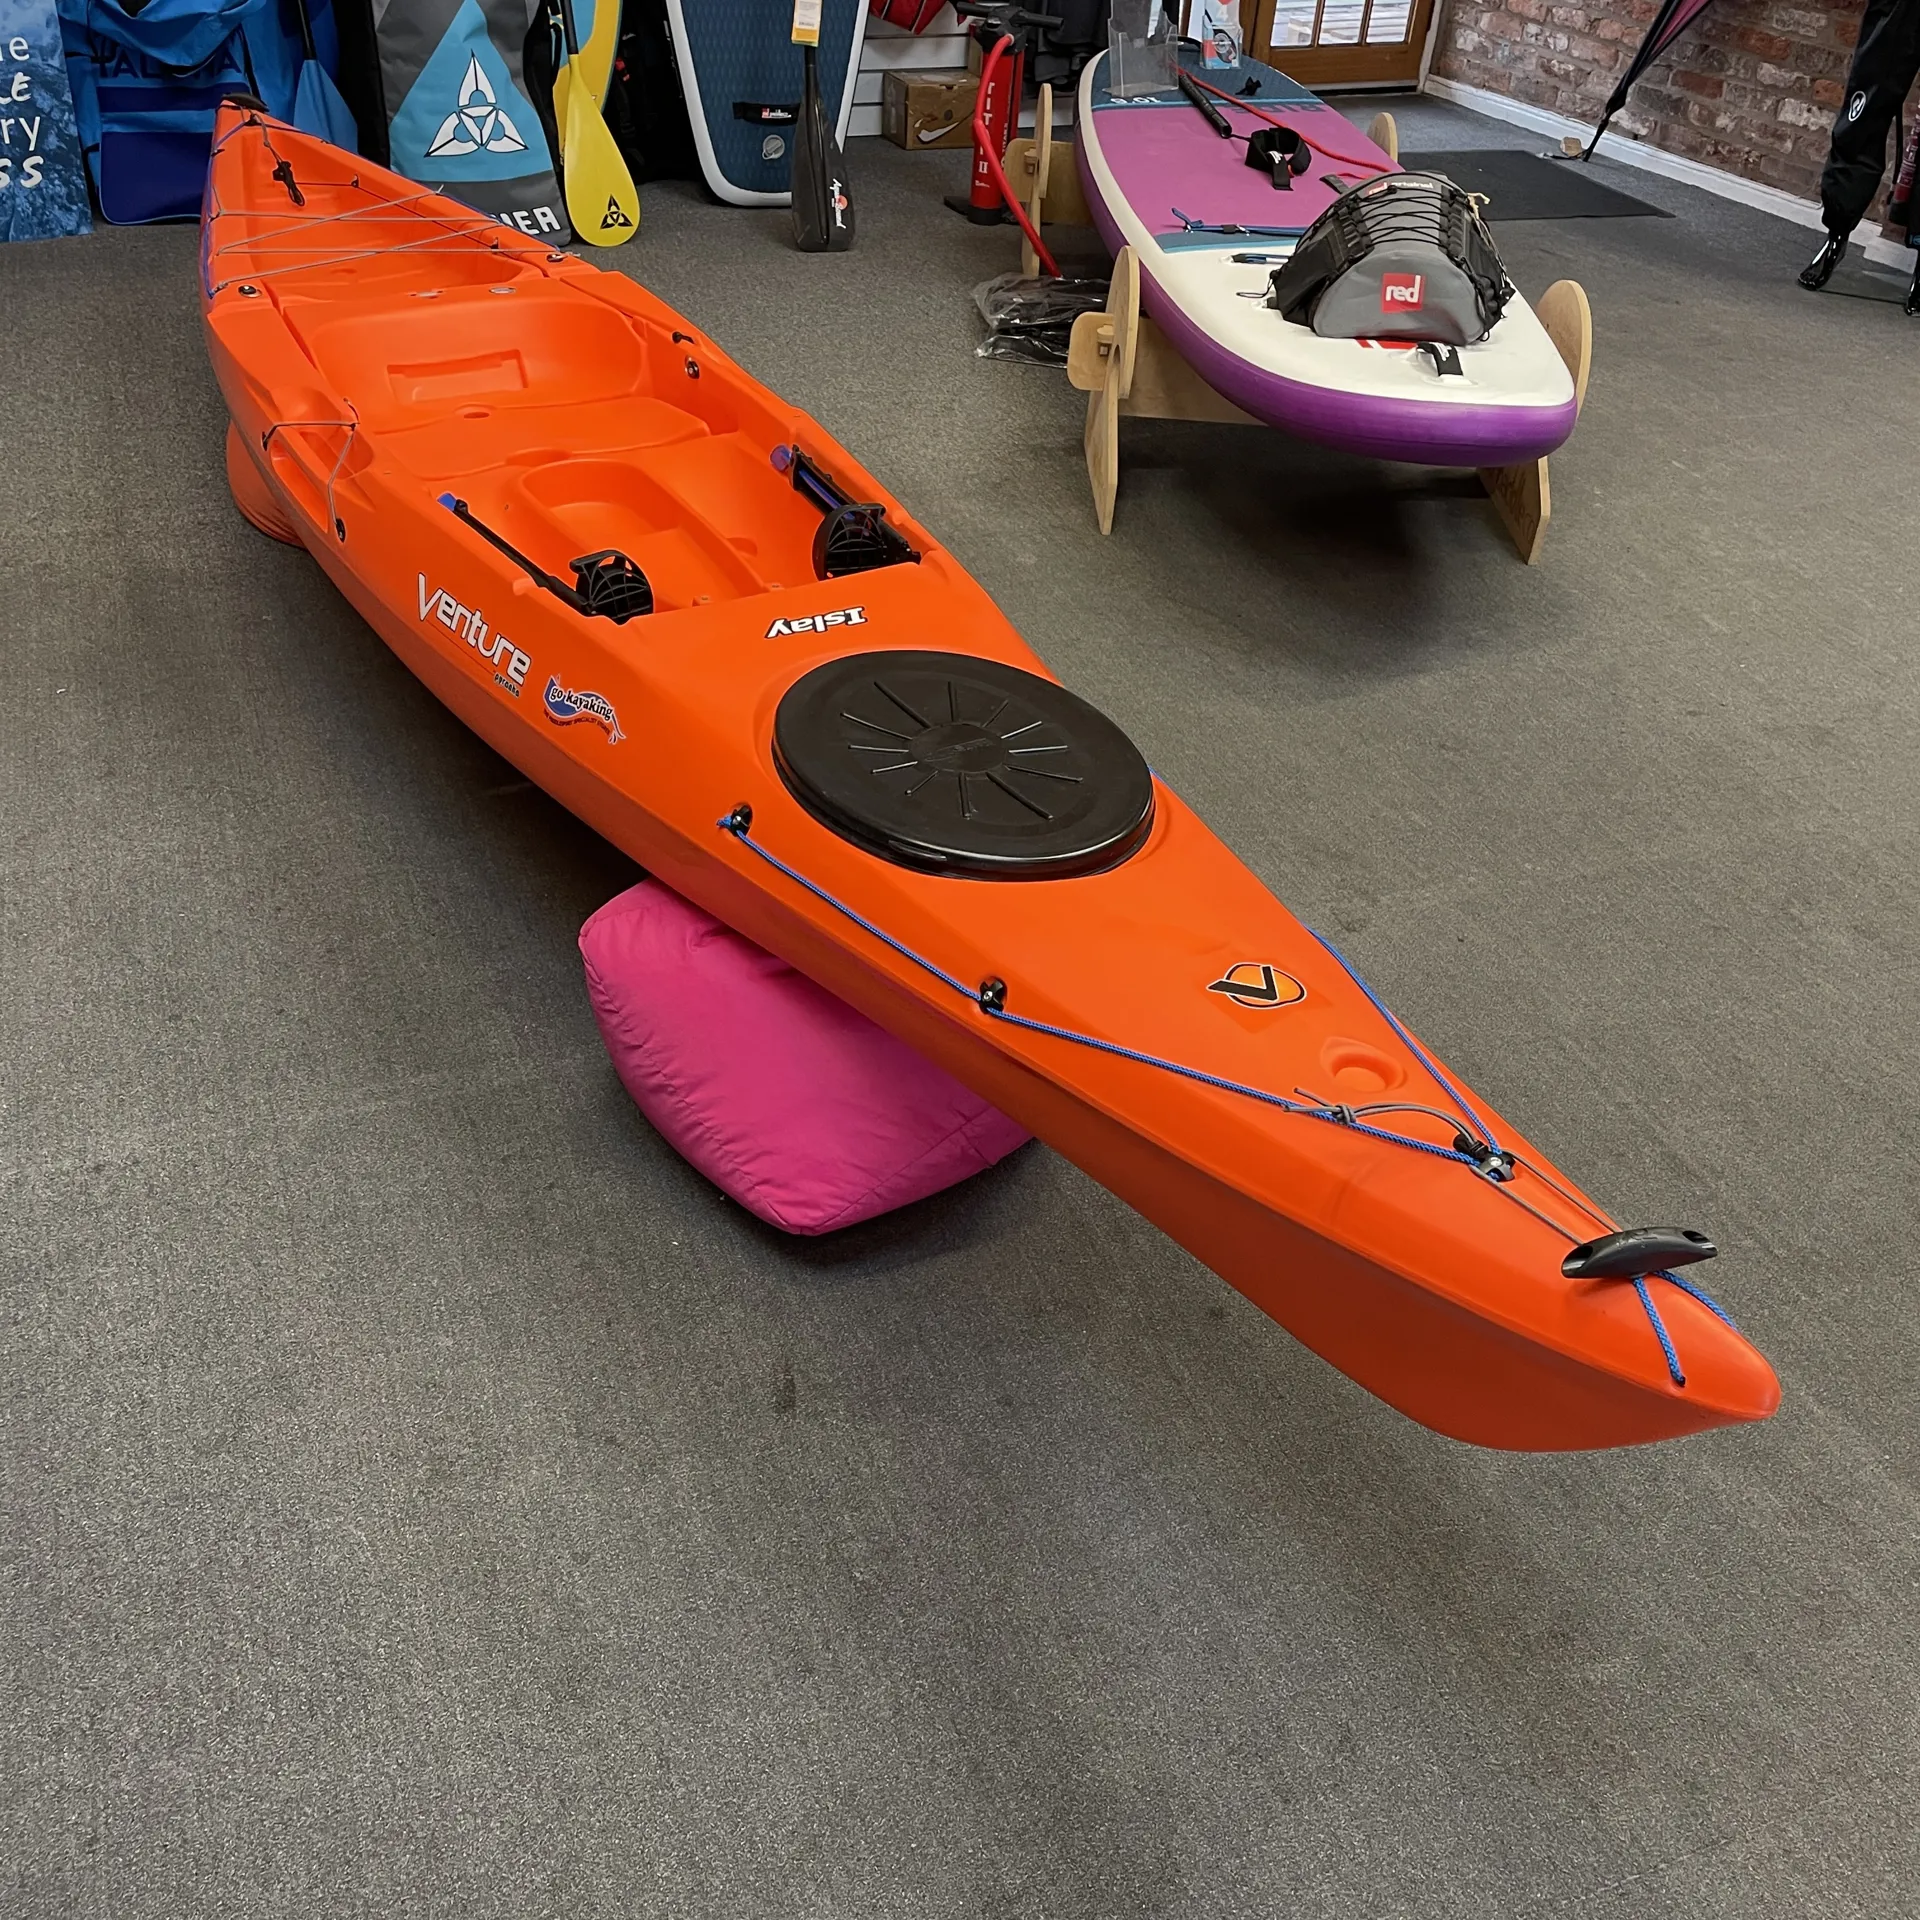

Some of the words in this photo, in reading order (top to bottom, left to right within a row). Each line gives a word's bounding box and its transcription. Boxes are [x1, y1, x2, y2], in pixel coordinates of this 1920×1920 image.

[0, 36, 30, 62] e
[1385, 274, 1421, 303] red
[418, 572, 532, 686] Venture
[765, 606, 868, 638] Islay
[550, 687, 564, 701] go
[565, 690, 613, 722] kayaking
